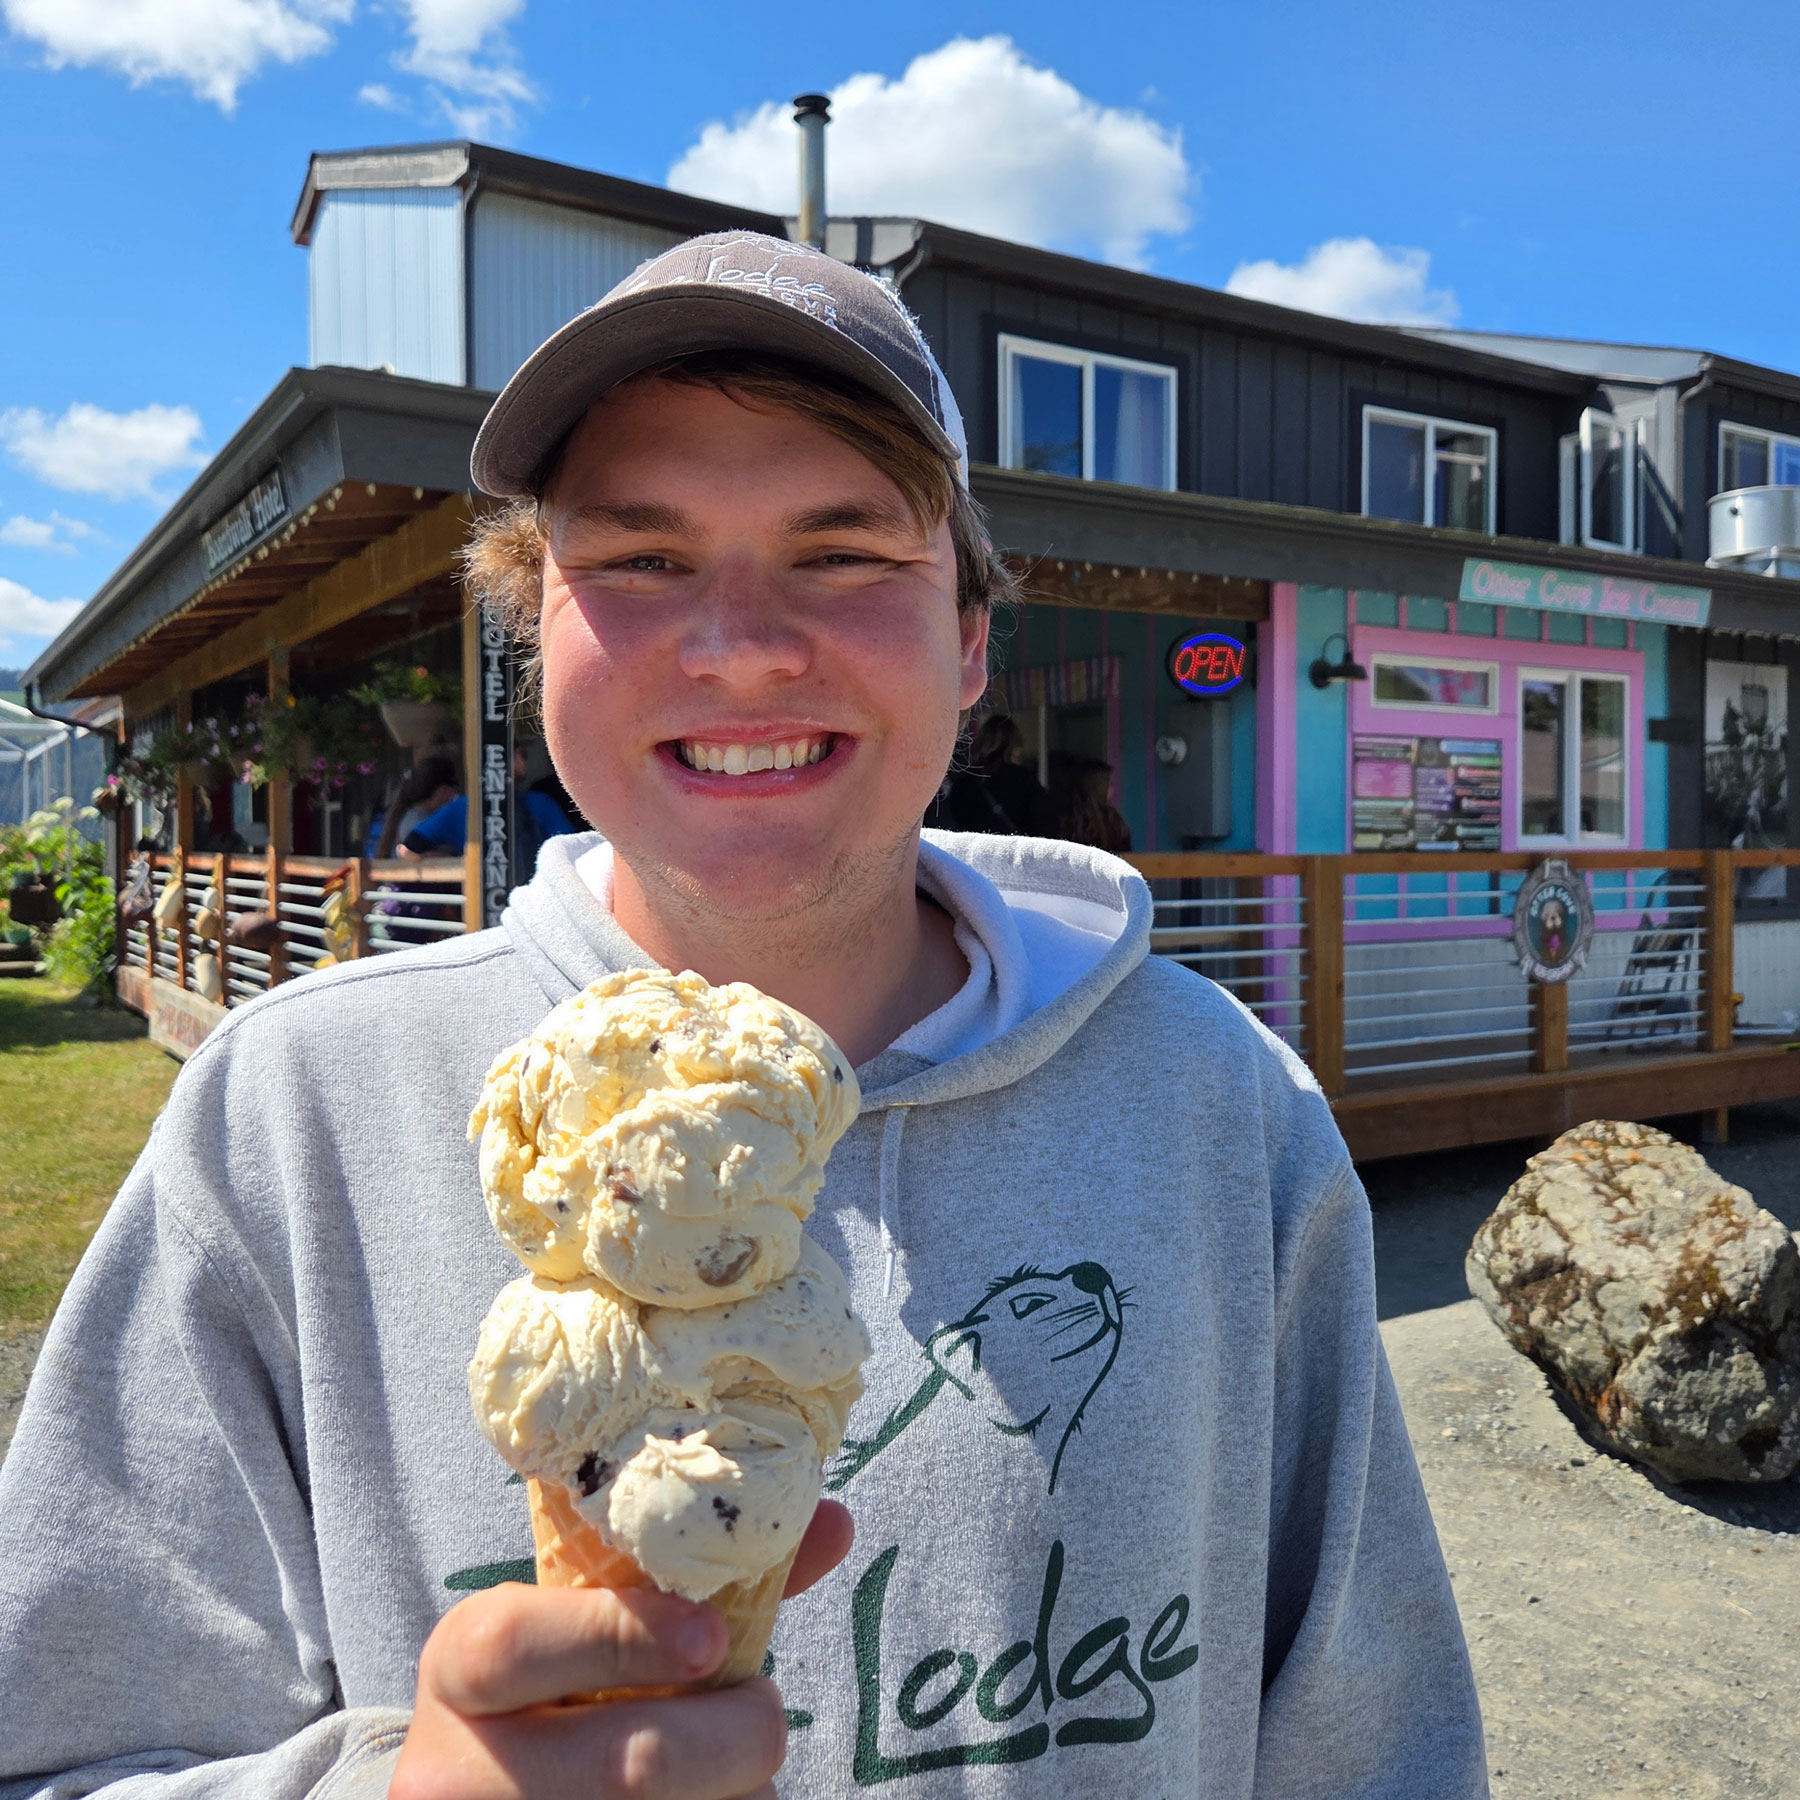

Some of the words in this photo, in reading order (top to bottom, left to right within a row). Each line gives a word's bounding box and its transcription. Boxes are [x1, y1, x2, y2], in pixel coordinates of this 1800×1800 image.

[250, 470, 285, 532] Hotel
[1472, 562, 1531, 600] Otter
[1540, 571, 1592, 608] Cove
[1599, 578, 1631, 611] Ice
[1639, 583, 1699, 620] Cream
[1175, 646, 1246, 680] OPEN
[852, 1539, 1200, 1786] Lodge
